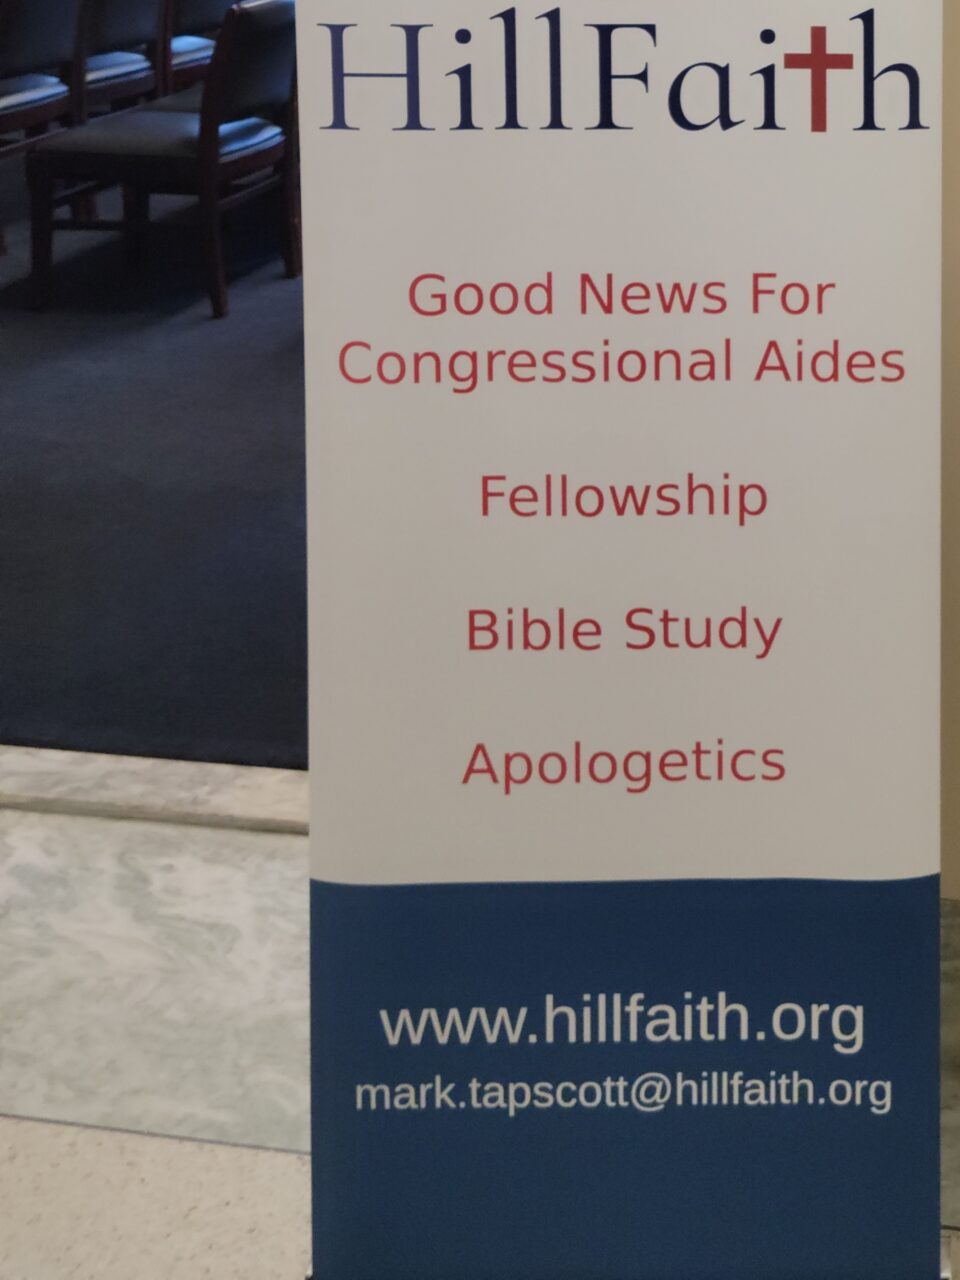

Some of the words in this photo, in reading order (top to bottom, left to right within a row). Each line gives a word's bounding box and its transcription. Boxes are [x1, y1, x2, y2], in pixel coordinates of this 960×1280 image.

[316, 6, 930, 133] HillFaith
[407, 271, 553, 316] Good
[578, 272, 728, 315] News
[751, 271, 836, 315] For
[337, 338, 733, 393] Congressional
[754, 338, 905, 383] Aides
[480, 472, 769, 527] Fellowship
[467, 607, 602, 651] Bible
[624, 606, 783, 659] Study
[461, 739, 787, 795] Apologetics
[379, 991, 866, 1054] www.hillfaith.org
[355, 1071, 892, 1117] mark.tapscott@hillfaith.org
